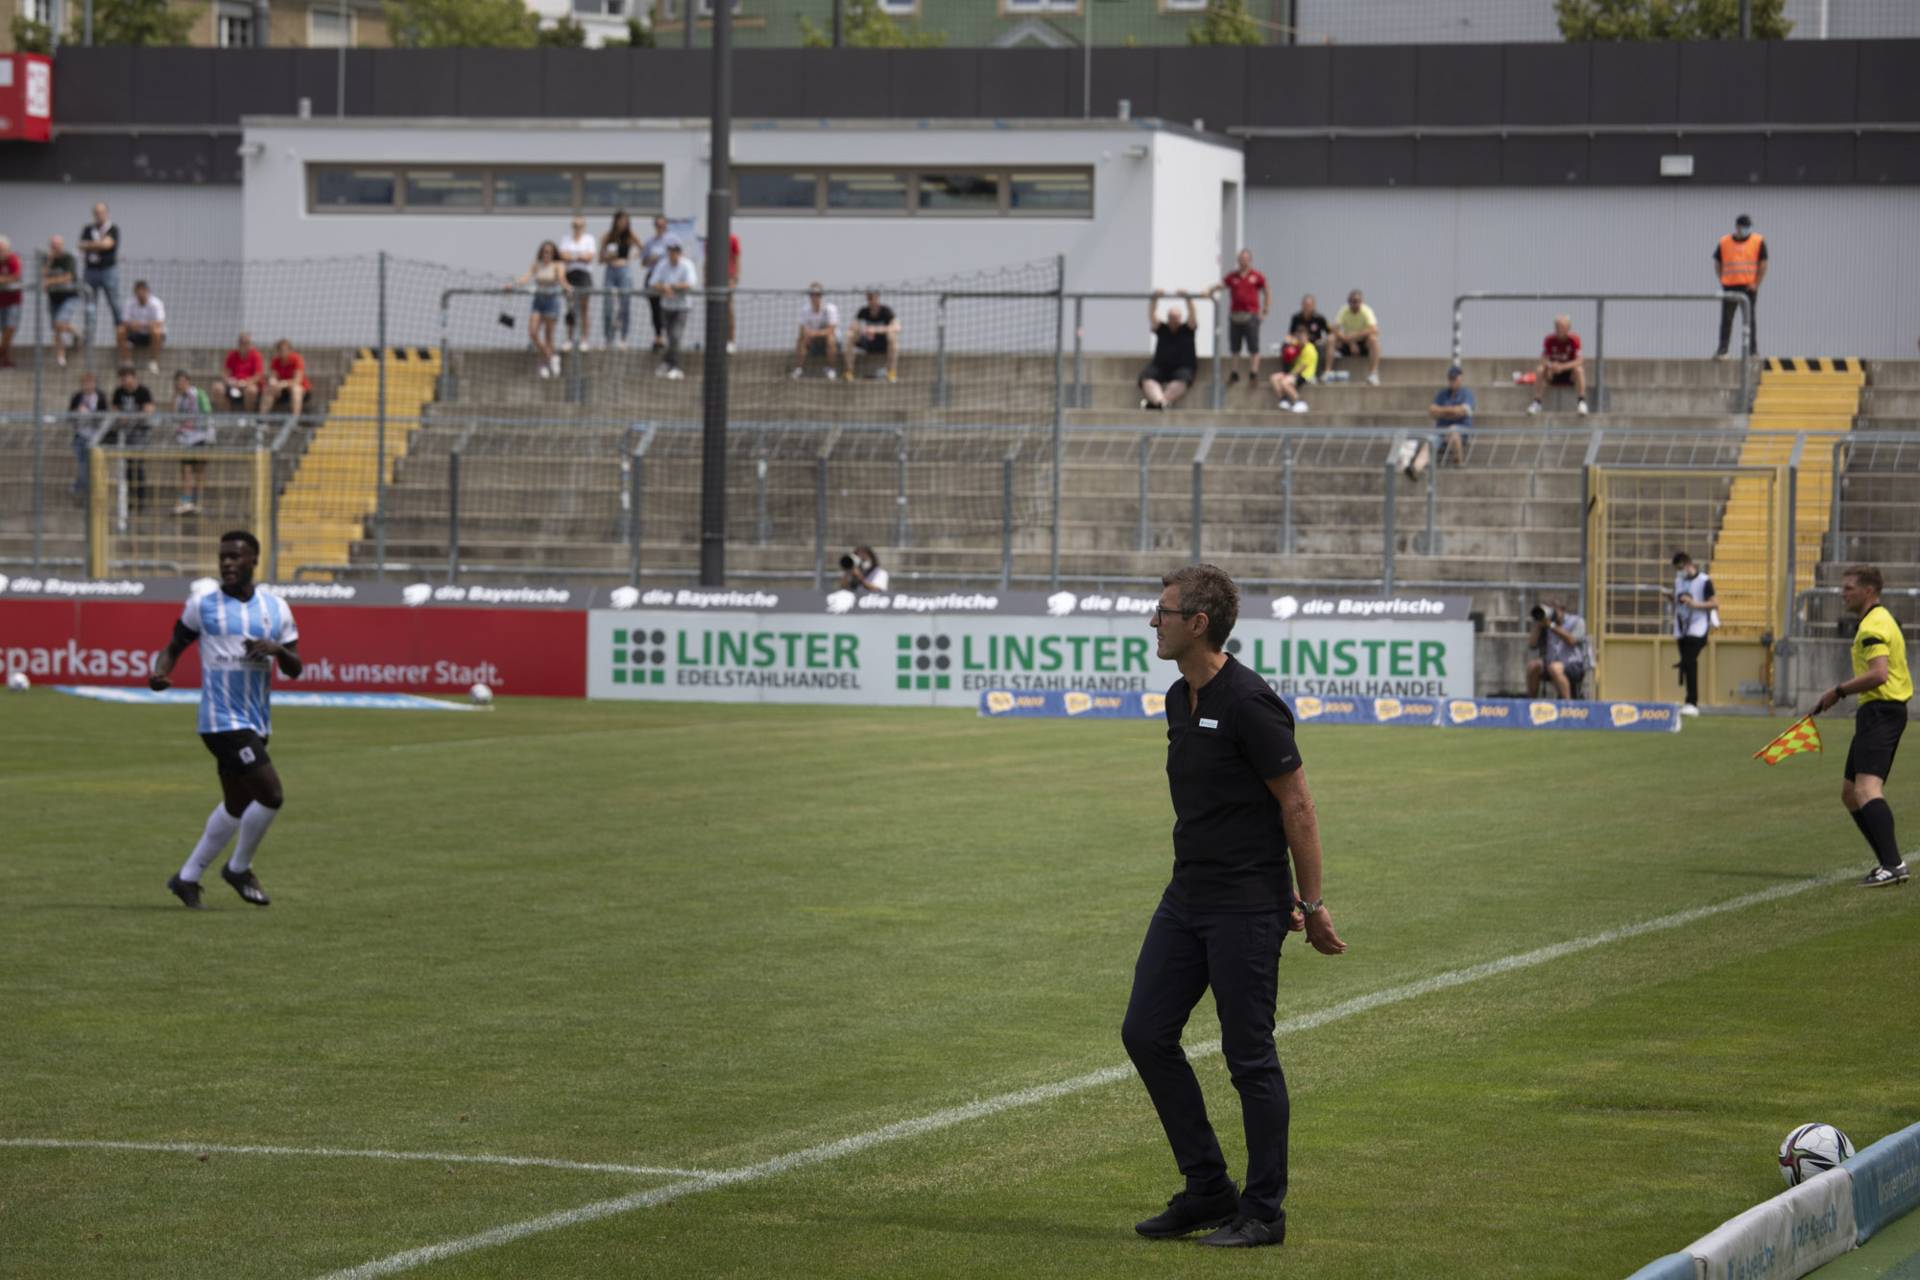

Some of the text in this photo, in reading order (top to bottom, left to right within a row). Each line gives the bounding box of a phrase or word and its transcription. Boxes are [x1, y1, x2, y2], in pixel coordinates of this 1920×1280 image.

[10, 577, 145, 596] die Bayerische
[434, 585, 570, 603] die Bayerische
[642, 589, 779, 608] die Bayerische
[858, 593, 999, 612] die Bayerische
[1080, 594, 1113, 611] die
[1302, 598, 1445, 616] die Bayerische
[677, 629, 861, 670] LINSTER
[962, 634, 1149, 673] LINSTER
[1254, 638, 1448, 677] LINSTER
[339, 662, 430, 684] unserer
[434, 660, 504, 687] Stadt.
[676, 668, 862, 690] EDELSTAHLHANDEL
[962, 674, 1148, 692] EDELSTAHLHANDEL
[1265, 678, 1448, 698] DELSTAHLHANDEL
